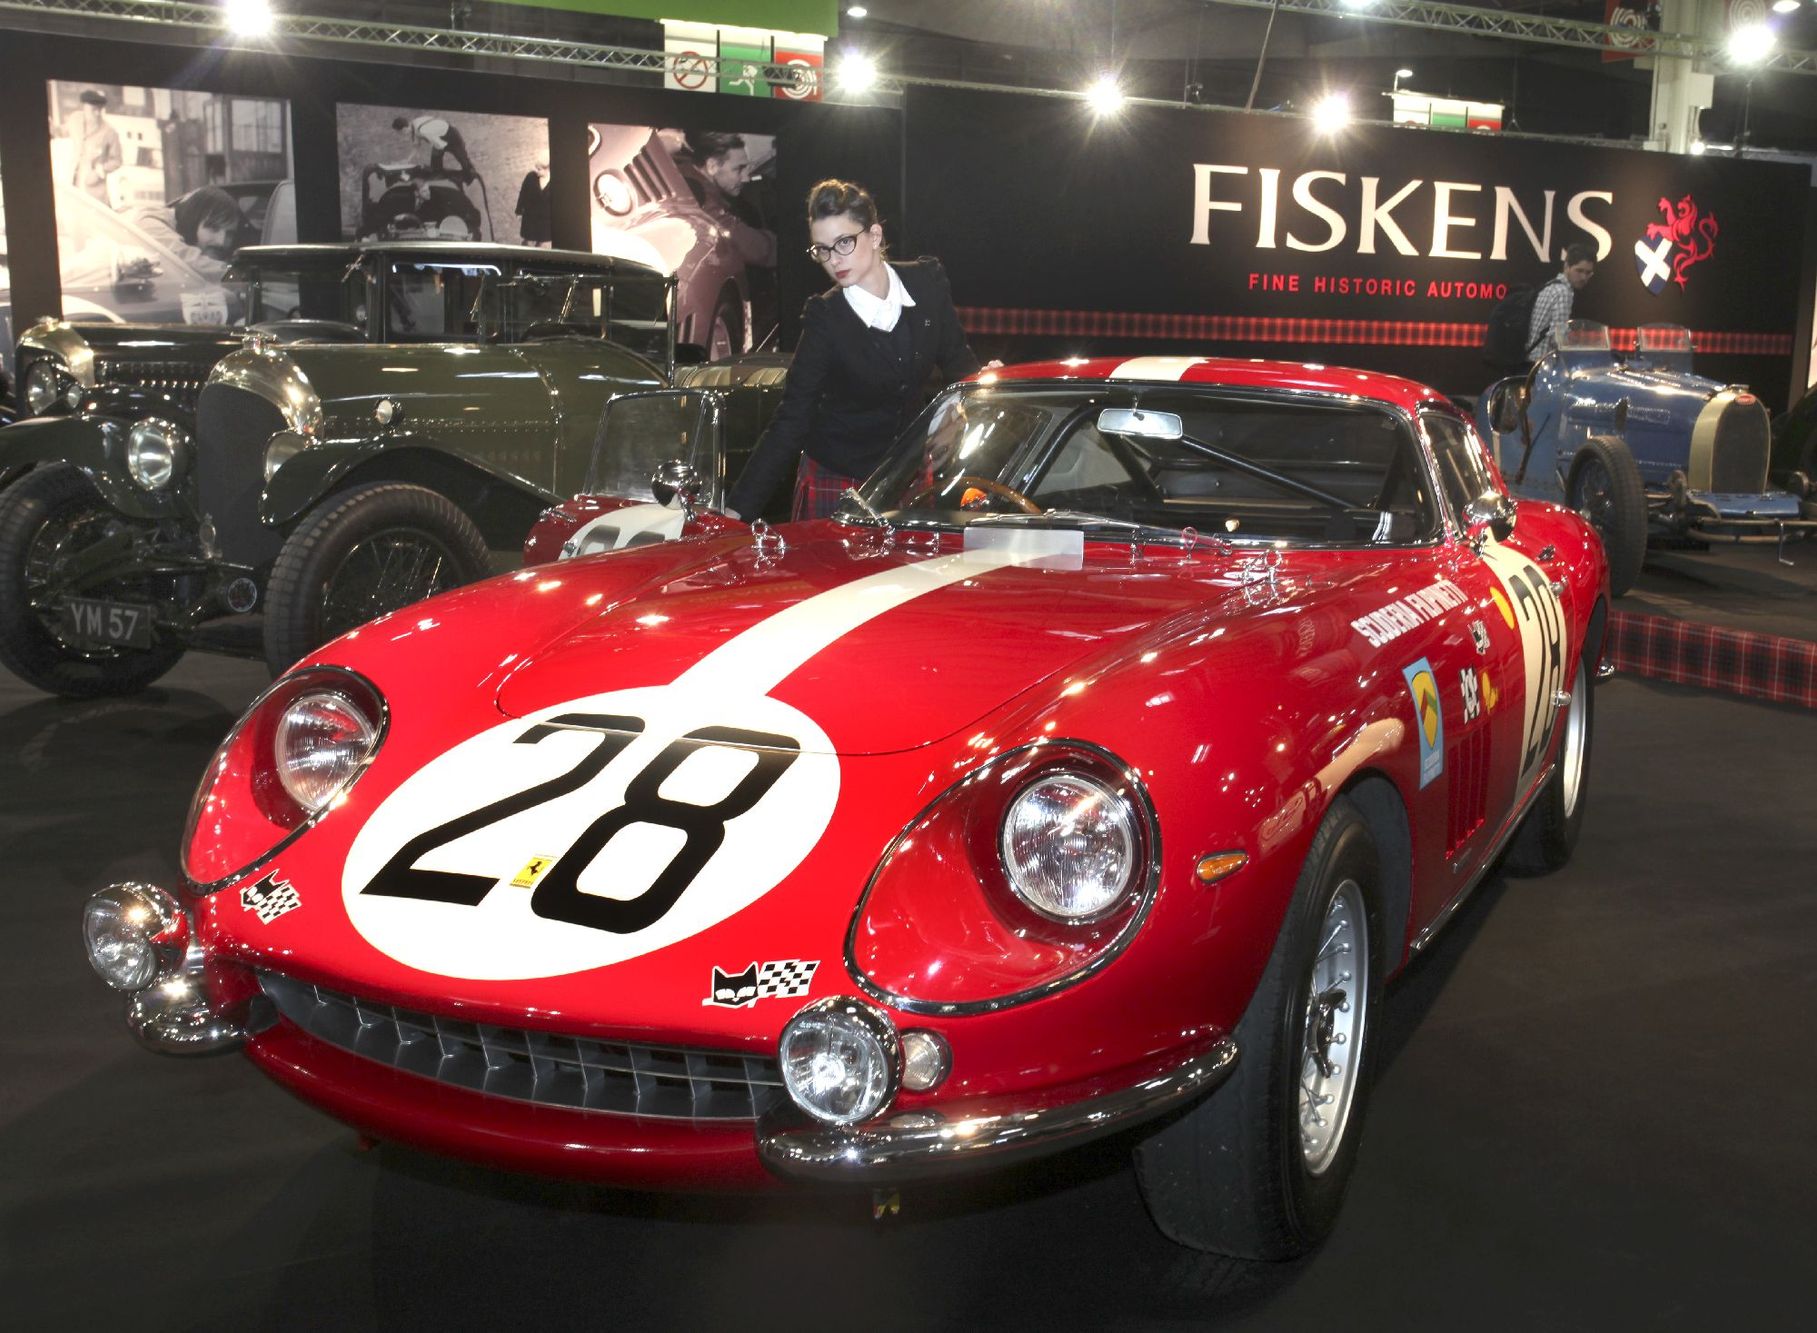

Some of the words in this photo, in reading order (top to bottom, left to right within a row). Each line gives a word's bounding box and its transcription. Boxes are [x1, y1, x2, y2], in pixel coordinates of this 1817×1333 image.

[1190, 164, 1613, 263] FISKENS
[1249, 273, 1300, 292] FINE
[1314, 276, 1416, 297] HISTORIC
[1427, 280, 1508, 300] AUTOMO
[70, 603, 101, 637] YM
[109, 608, 139, 641] 57
[359, 713, 800, 934] 28
